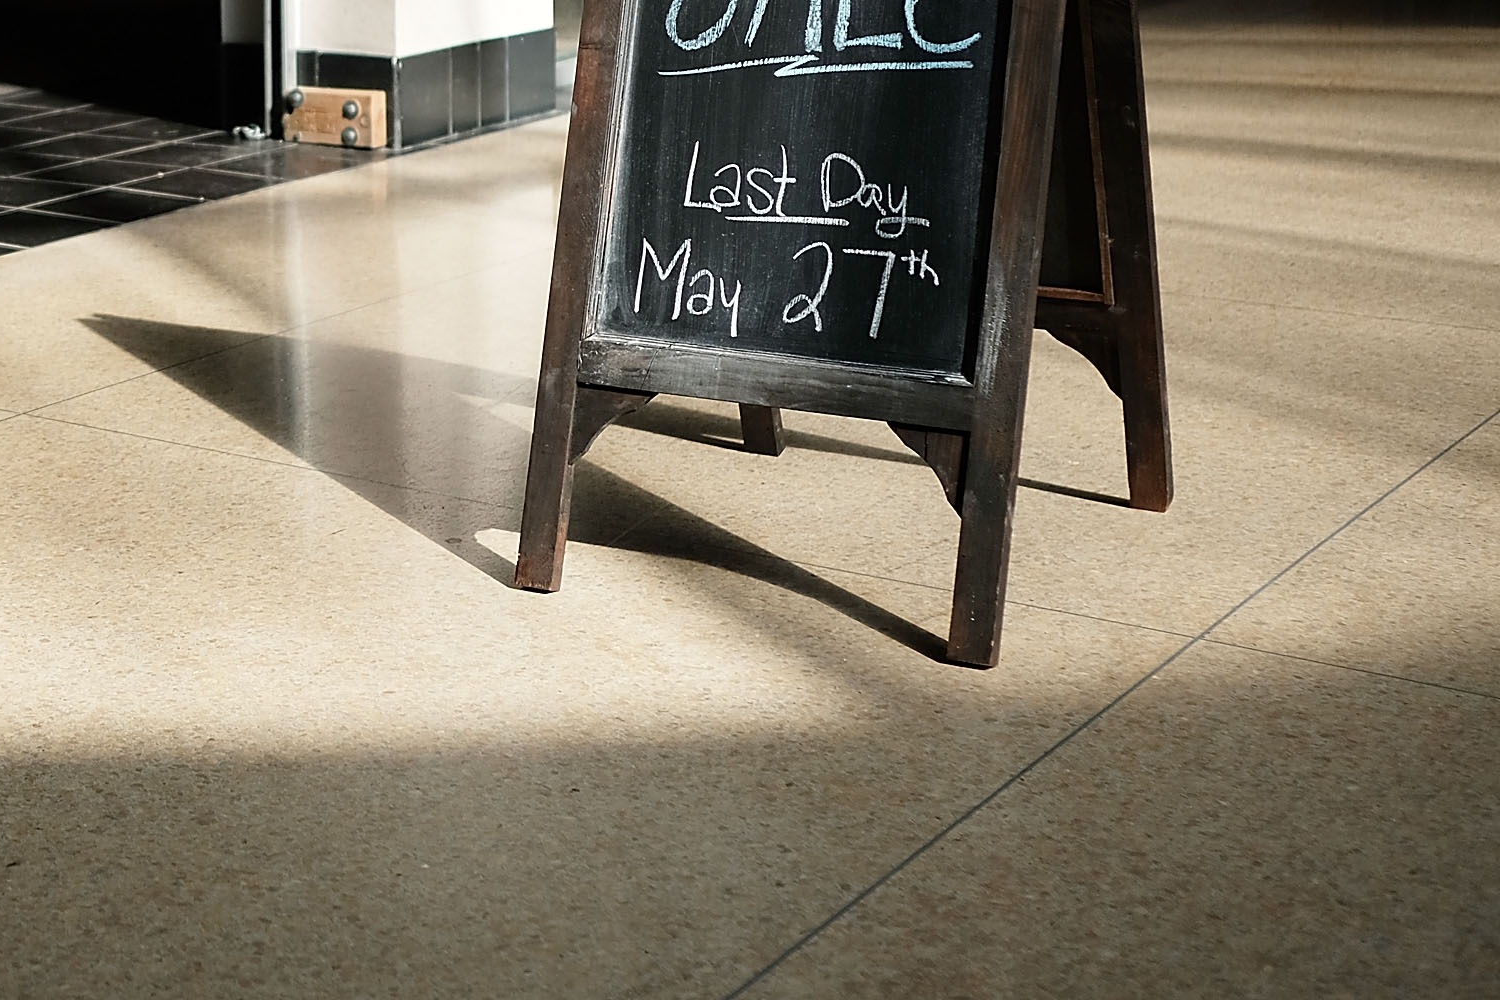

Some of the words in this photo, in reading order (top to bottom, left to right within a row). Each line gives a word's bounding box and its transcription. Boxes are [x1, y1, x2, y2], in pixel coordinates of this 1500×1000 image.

[683, 140, 797, 217] Last
[821, 151, 931, 239] Day
[634, 237, 743, 338] May
[782, 240, 941, 339] 27th
